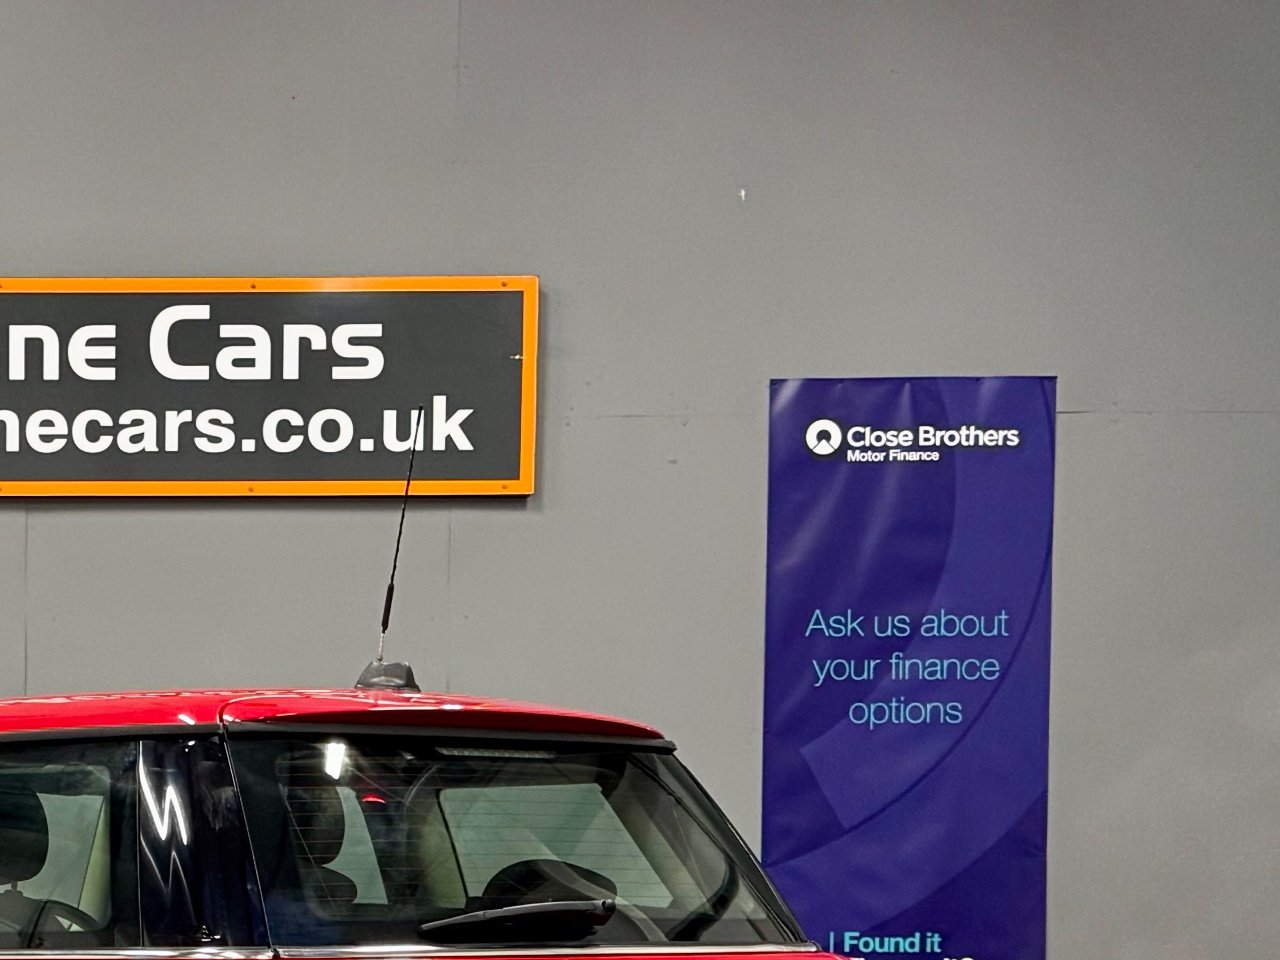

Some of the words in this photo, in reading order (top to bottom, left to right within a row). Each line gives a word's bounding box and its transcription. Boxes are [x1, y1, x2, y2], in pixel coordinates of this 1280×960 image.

[149, 304, 385, 380] Cars
[847, 426, 914, 447] Close
[918, 425, 1019, 447] Brothers
[847, 450, 886, 462] Motor
[889, 449, 940, 461] Finance
[805, 609, 865, 637] Ask
[874, 613, 910, 637] us
[920, 609, 1009, 636] about
[812, 657, 881, 687] your
[889, 653, 1000, 680] finance
[848, 697, 962, 730] options
[844, 931, 920, 953] Found
[926, 931, 942, 953] it
